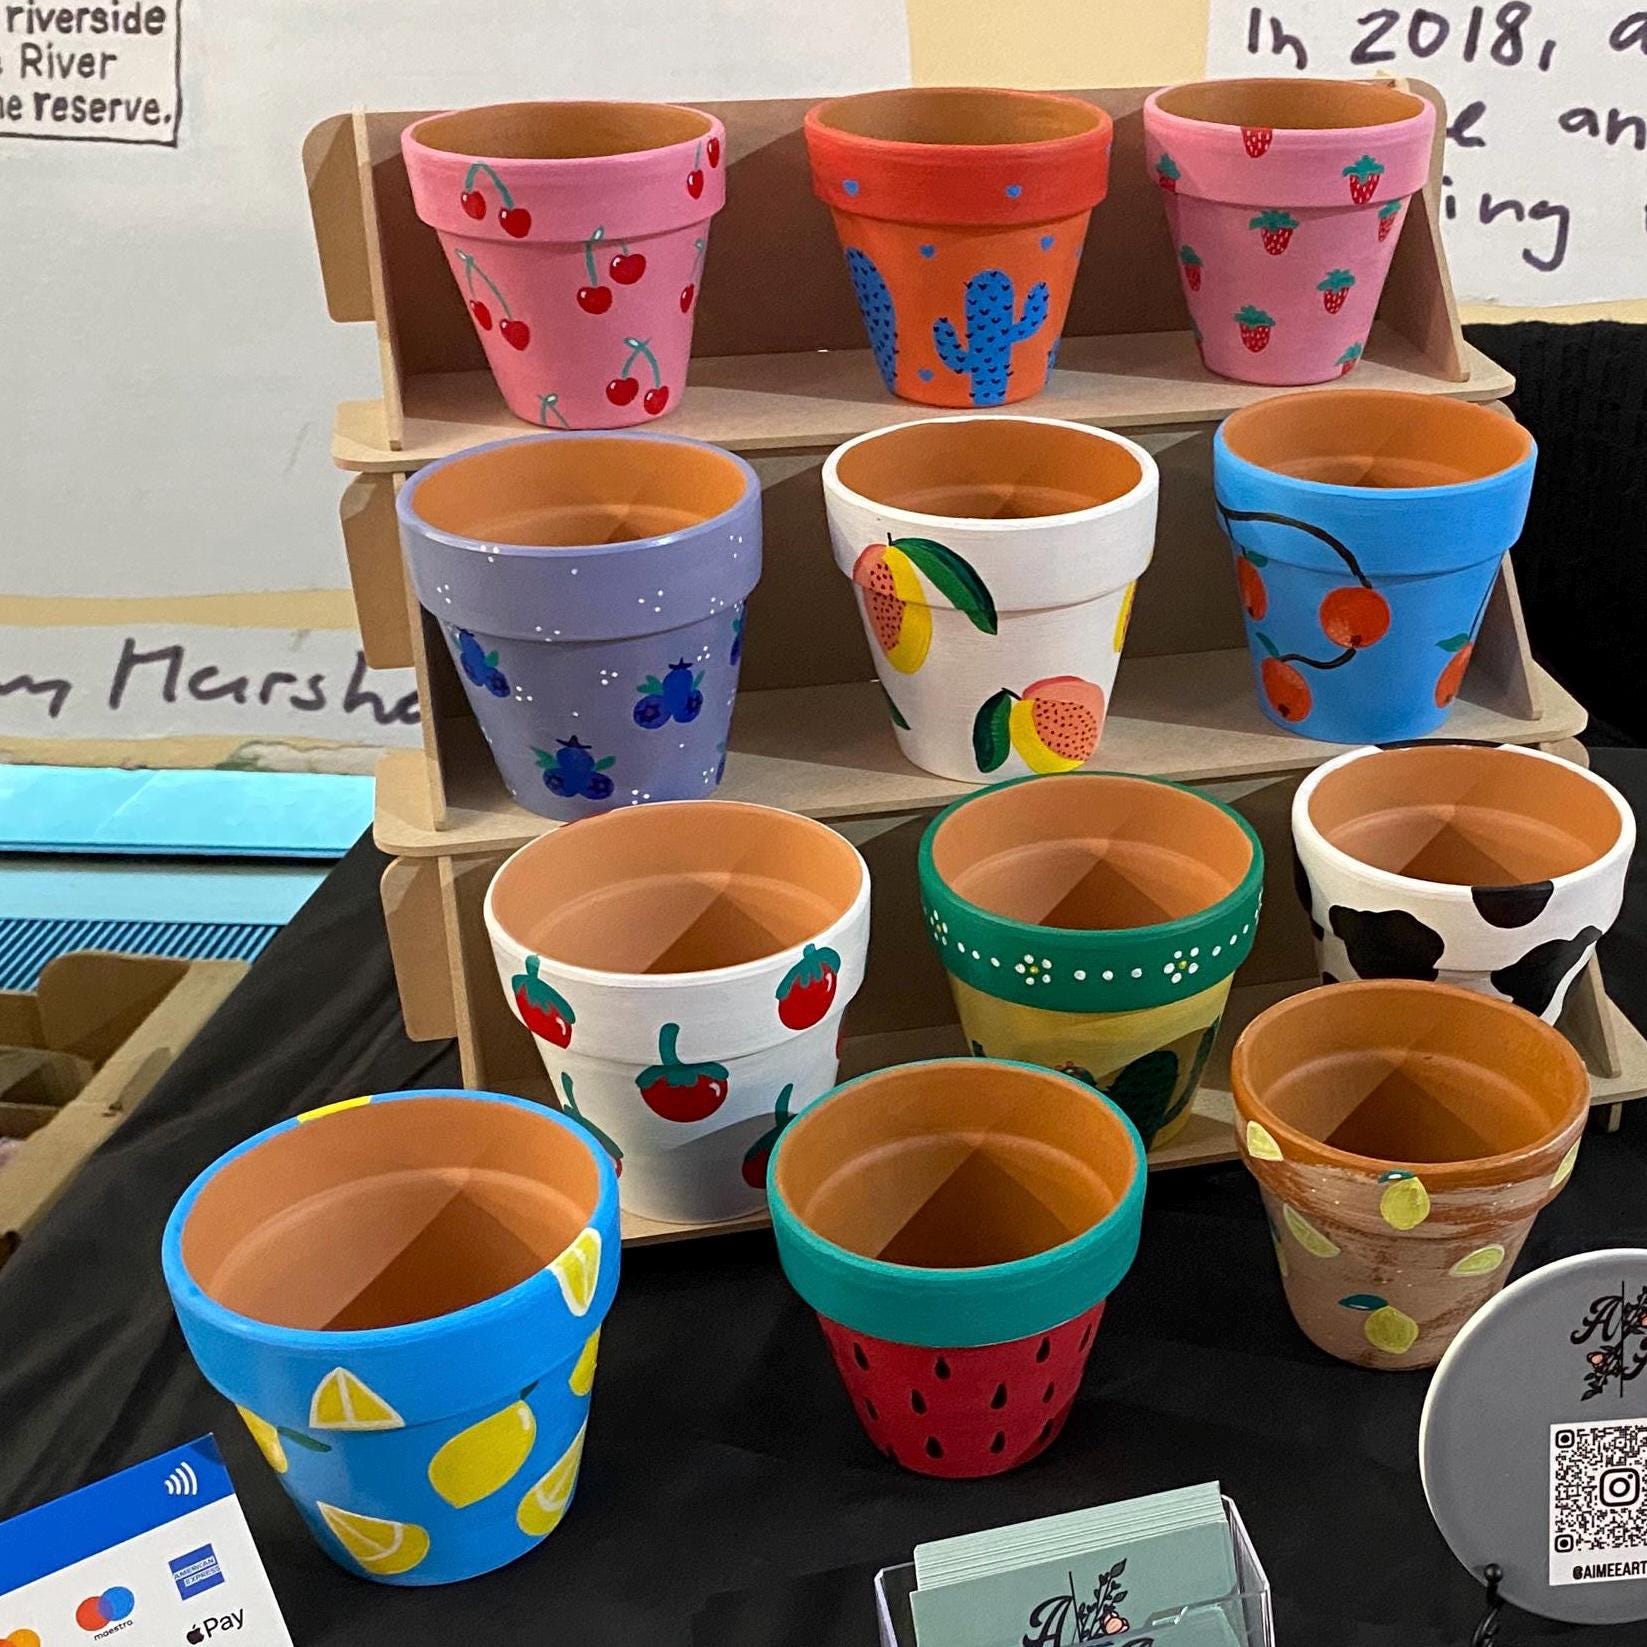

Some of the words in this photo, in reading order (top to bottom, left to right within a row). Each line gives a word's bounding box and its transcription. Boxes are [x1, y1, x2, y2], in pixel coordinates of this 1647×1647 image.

[6, 0, 166, 35] riverside
[1248, 7, 1308, 70] In
[1350, 0, 1557, 72] 2018,
[20, 42, 117, 80] River
[33, 91, 171, 126] reserve.
[174, 1558, 214, 1580] AMERICAN
[185, 1565, 221, 1585] EXPRESS
[93, 1619, 133, 1641] maestro
[202, 1608, 243, 1638] Pay
